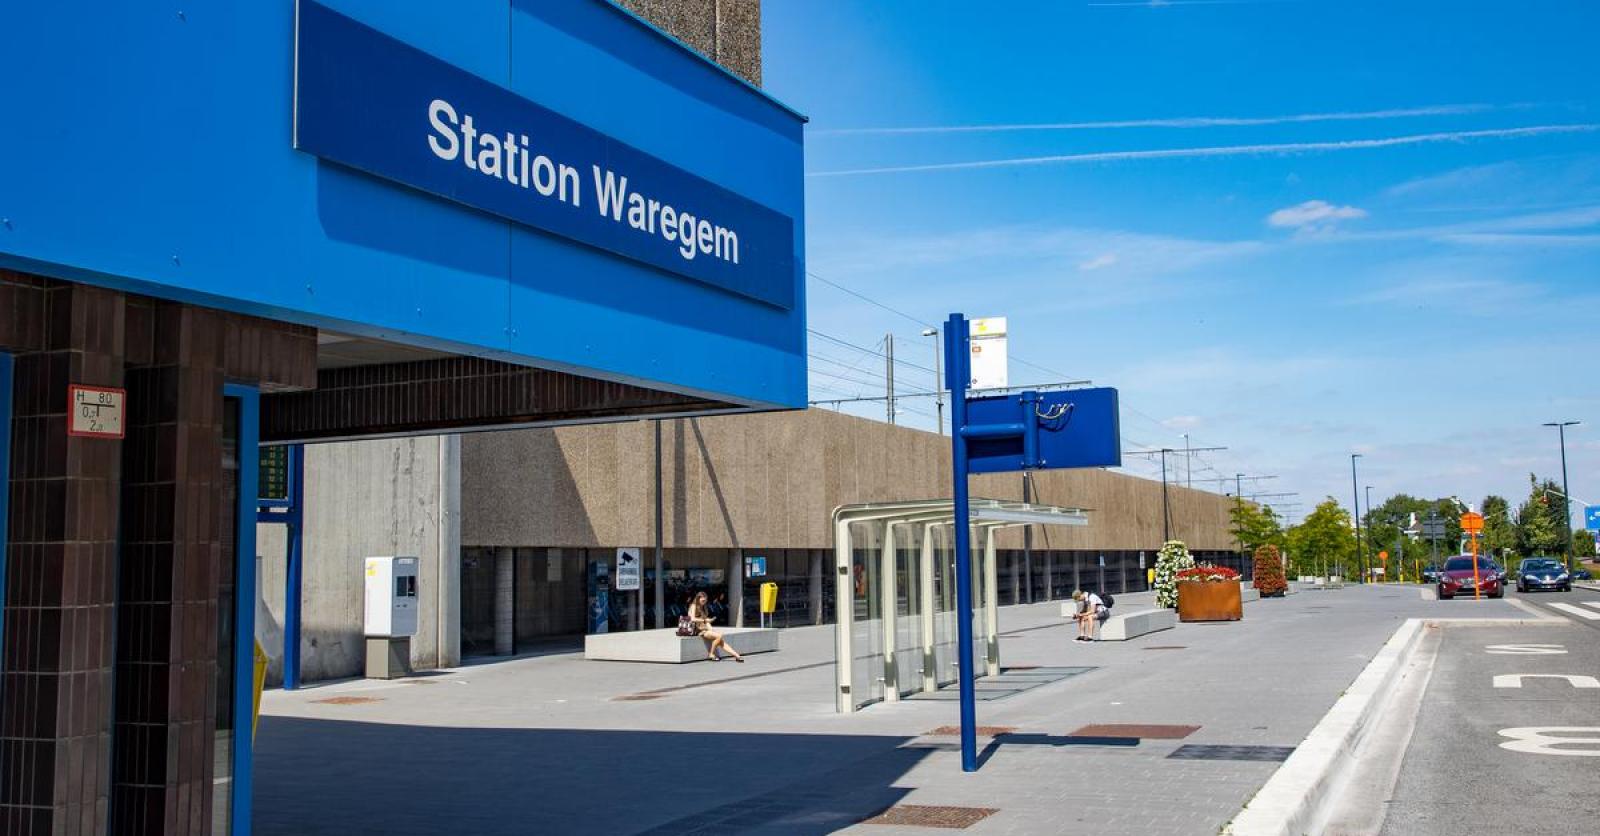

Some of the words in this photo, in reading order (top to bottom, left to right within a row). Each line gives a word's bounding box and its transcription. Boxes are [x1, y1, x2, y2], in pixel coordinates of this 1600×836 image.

[428, 99, 580, 207] Station
[592, 164, 739, 264] Waregem
[77, 390, 85, 401] H
[98, 392, 113, 404] 80
